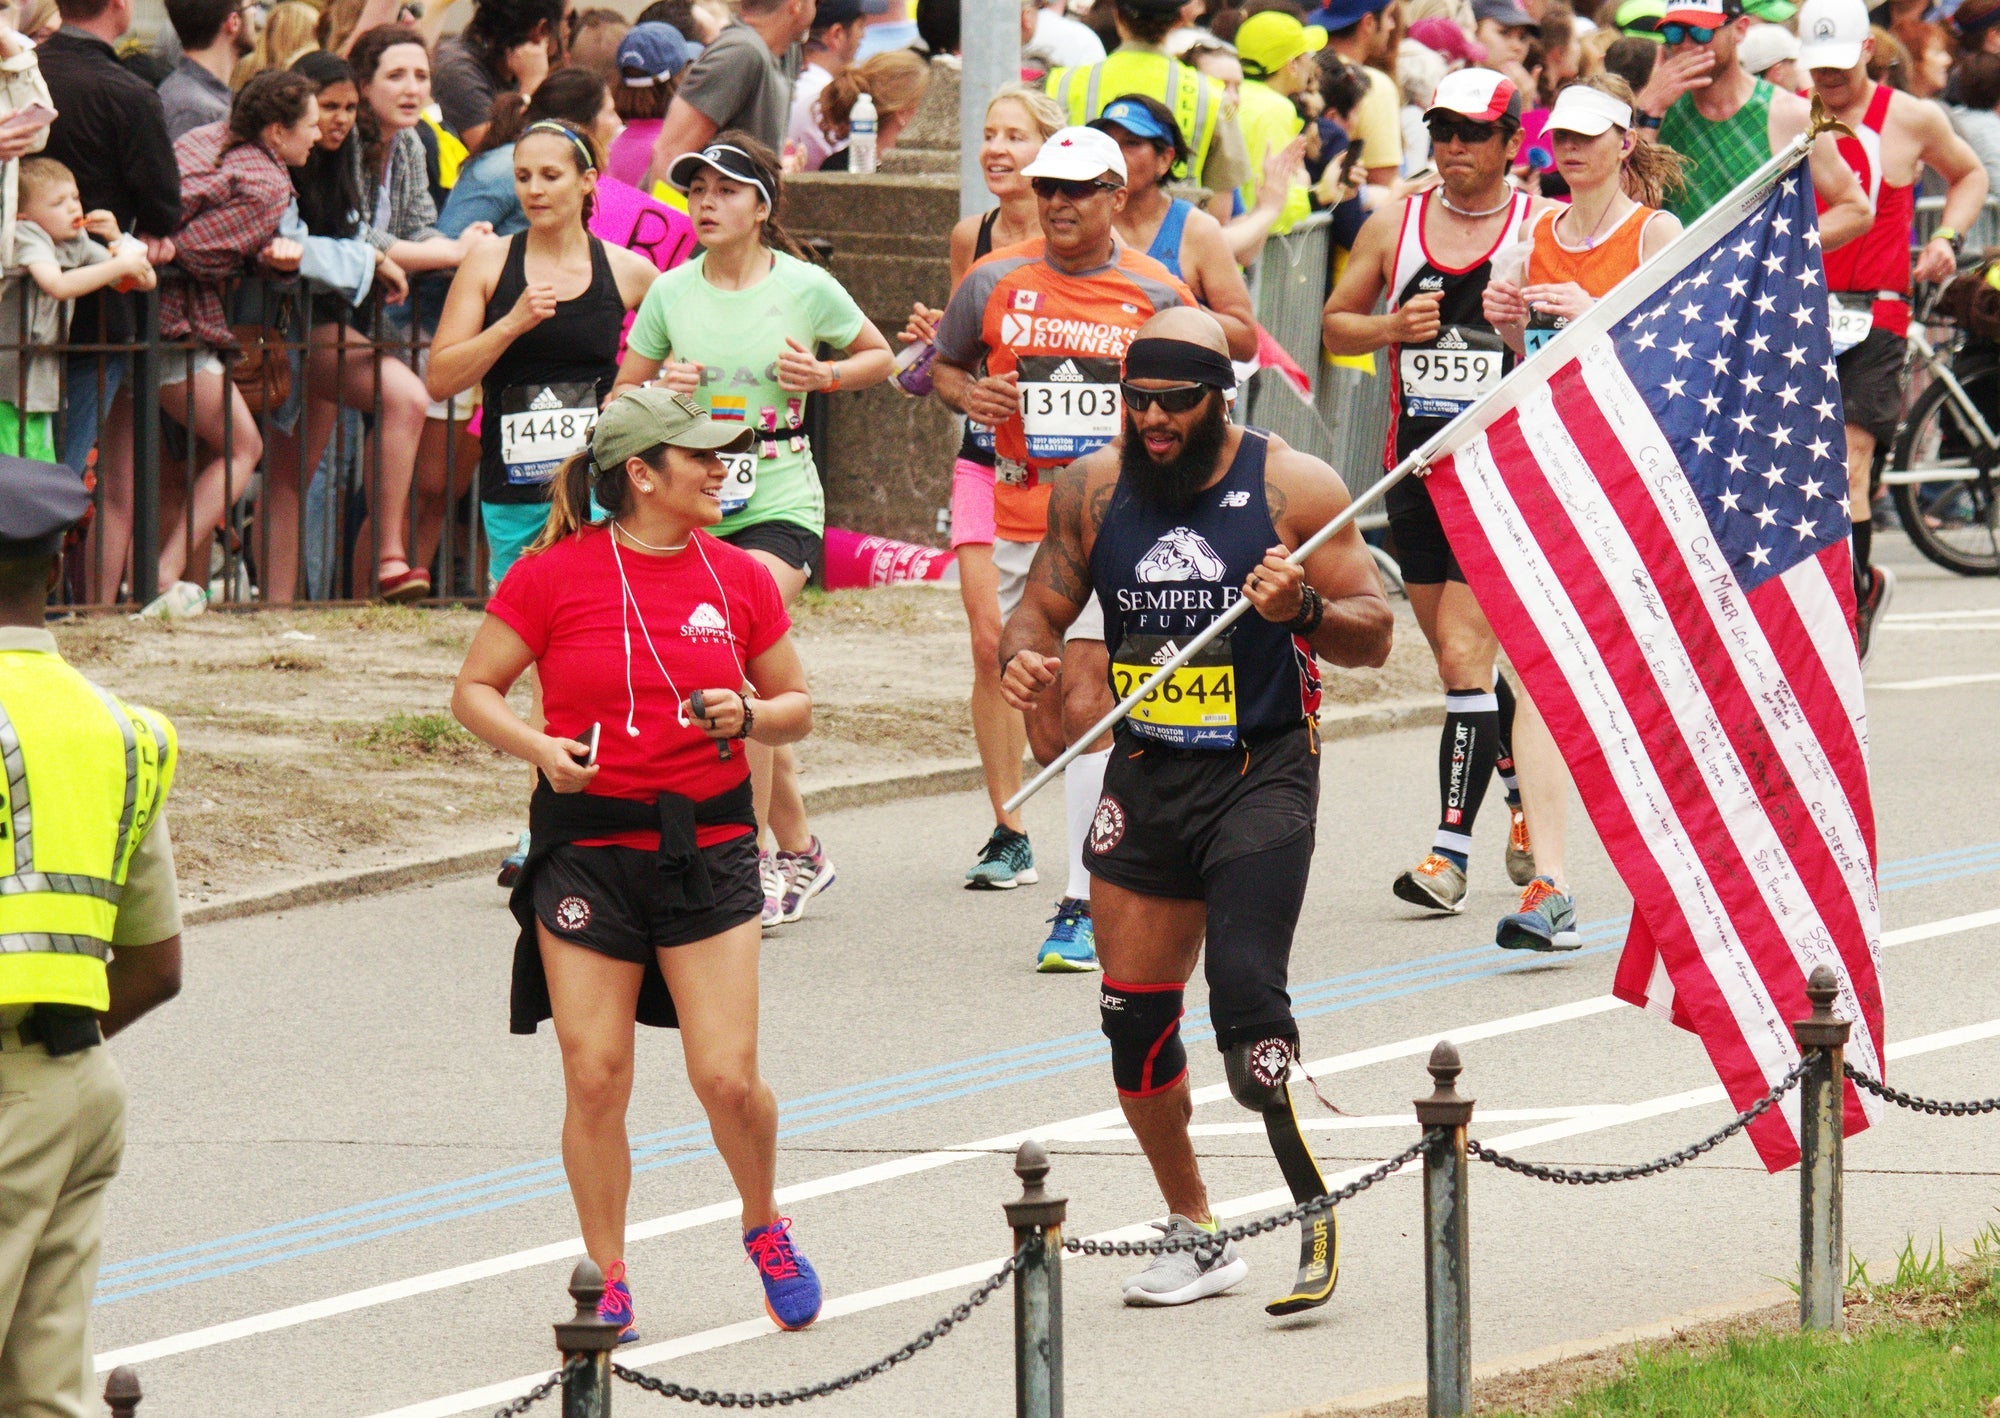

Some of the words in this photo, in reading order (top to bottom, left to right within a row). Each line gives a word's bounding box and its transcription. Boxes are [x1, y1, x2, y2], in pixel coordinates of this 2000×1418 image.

[1034, 317, 1138, 342] CONNOR'S
[1033, 333, 1129, 358] RUNNER
[1437, 340, 1468, 350] adidas
[1049, 373, 1084, 382] adidas
[1413, 355, 1489, 382] 9559
[1406, 382, 1415, 394] 2
[530, 401, 563, 410] adidas
[1022, 388, 1116, 416] 13103
[506, 413, 595, 445] 14487
[1048, 437, 1073, 445] BOSTON
[505, 449, 511, 460] 7
[1680, 485, 1701, 520] LYNCH
[1117, 588, 1214, 611] SEMPER
[1709, 574, 1740, 622] MINER
[680, 625, 725, 637] SEMPER
[692, 636, 728, 645] FUND
[1116, 671, 1233, 704] 28644
[1143, 723, 1157, 731] 2017
[1158, 726, 1184, 736] BOSTON
[1145, 729, 1184, 743] MARATHON
[1749, 751, 1777, 800] ARMY
[1561, 621, 1575, 641] every
[1630, 759, 1644, 788] during
[1646, 792, 1661, 817] their
[1660, 817, 1673, 837] 2011
[1672, 838, 1686, 858] tour
[1694, 875, 1715, 916] Helmand
[1767, 1018, 1788, 1056] Brothers
[1825, 826, 1854, 871] DREYER
[1754, 849, 1771, 874] SGT
[1795, 937, 1820, 963] SGT
[1810, 926, 1835, 957] SGT
[1834, 965, 1859, 1022] SEVERSON
[1252, 1037, 1291, 1059] AFFLICTION
[1254, 1068, 1272, 1086] LIVE
